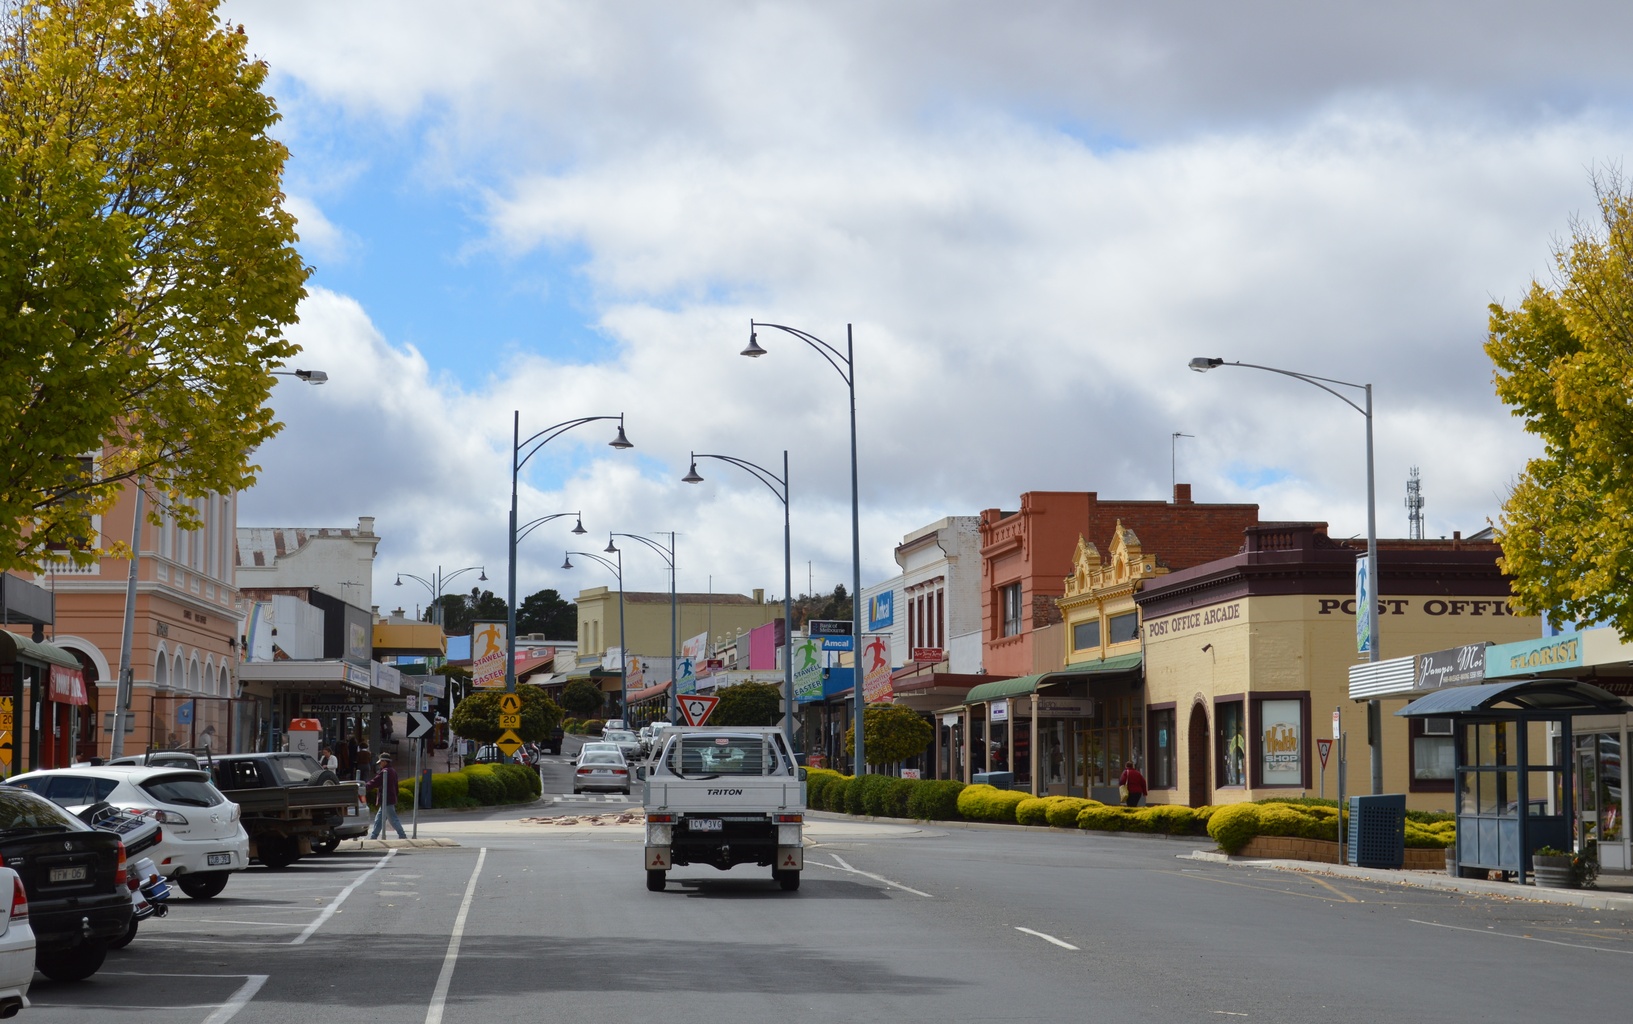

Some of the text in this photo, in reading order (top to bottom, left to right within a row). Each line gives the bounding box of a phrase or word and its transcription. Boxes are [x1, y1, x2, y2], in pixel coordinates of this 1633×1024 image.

[876, 598, 890, 620] Amcal
[1423, 599, 1541, 616] OFFI
[1149, 603, 1240, 637] POST OFFICE ARCADE
[824, 639, 849, 648] Amcal
[473, 651, 505, 667] STAWELL
[1510, 637, 1578, 670] FLORIST
[794, 663, 822, 678] STAWELL
[864, 664, 892, 681] STAWELL
[1418, 645, 1484, 687] Pamper Moi
[473, 669, 504, 686] EASTER
[794, 681, 822, 696] EASTER
[864, 684, 893, 702] EASTER
[311, 704, 364, 712] PHARMACY
[3, 714, 12, 725] 20
[503, 715, 516, 724] 20
